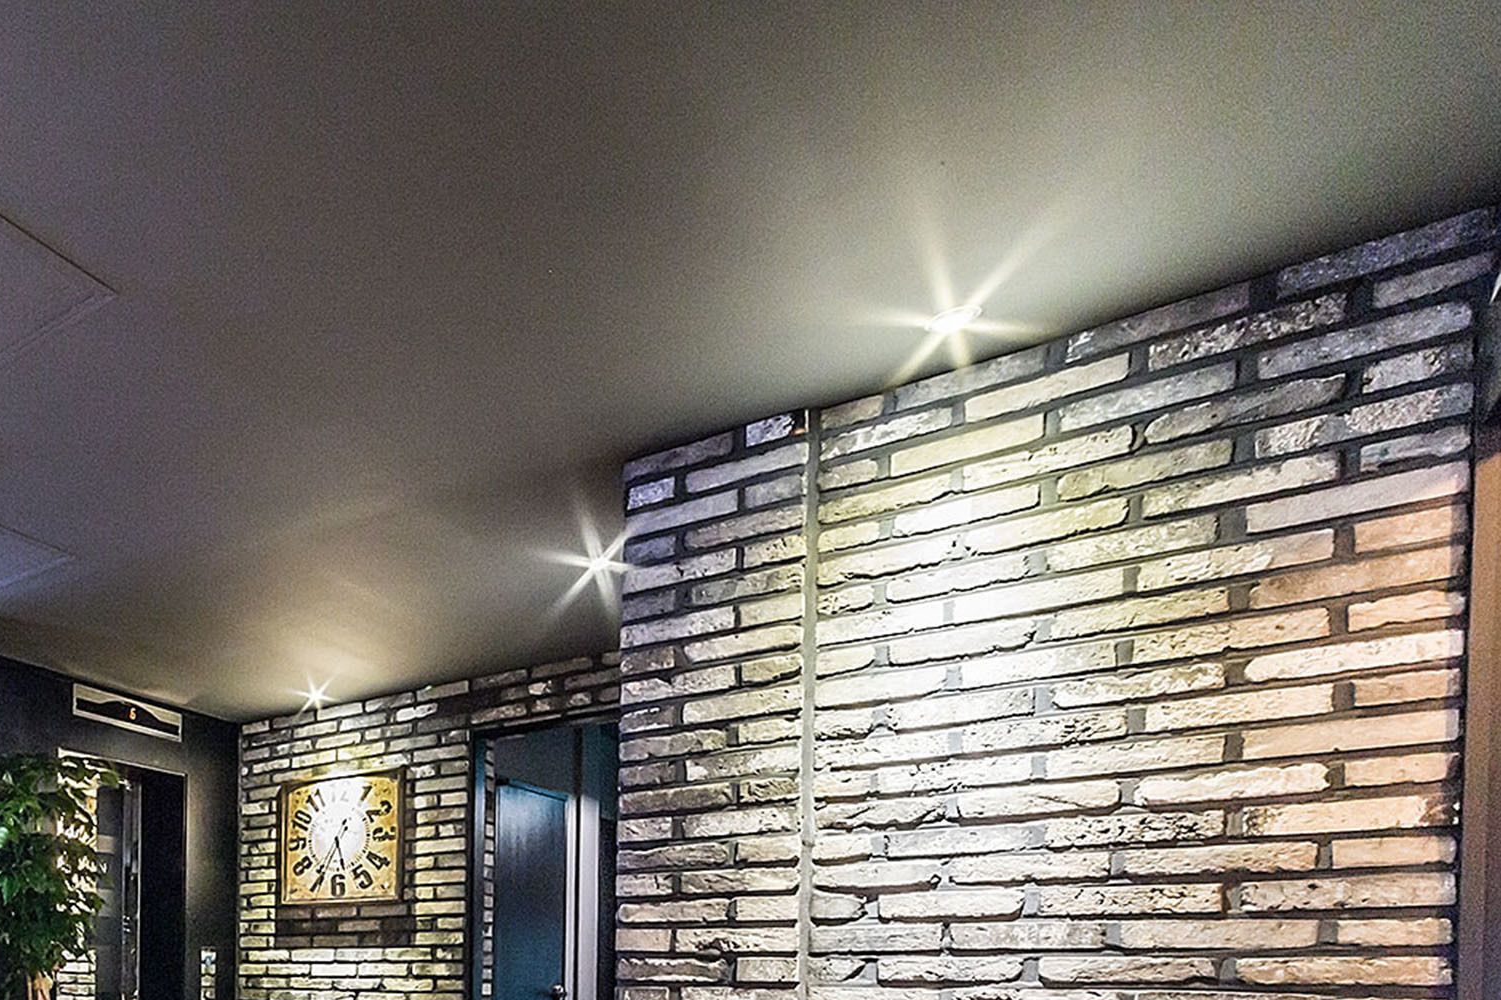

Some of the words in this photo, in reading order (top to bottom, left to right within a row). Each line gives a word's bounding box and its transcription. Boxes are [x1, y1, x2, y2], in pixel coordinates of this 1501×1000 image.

[305, 788, 325, 812] 11
[361, 785, 373, 801] 1
[292, 810, 312, 832] 10
[365, 800, 392, 823] 2
[288, 836, 306, 851] 9
[372, 826, 396, 841] 3
[293, 856, 313, 876] 8
[366, 851, 391, 870] 4
[331, 874, 346, 896] 6
[351, 864, 373, 889] 5
